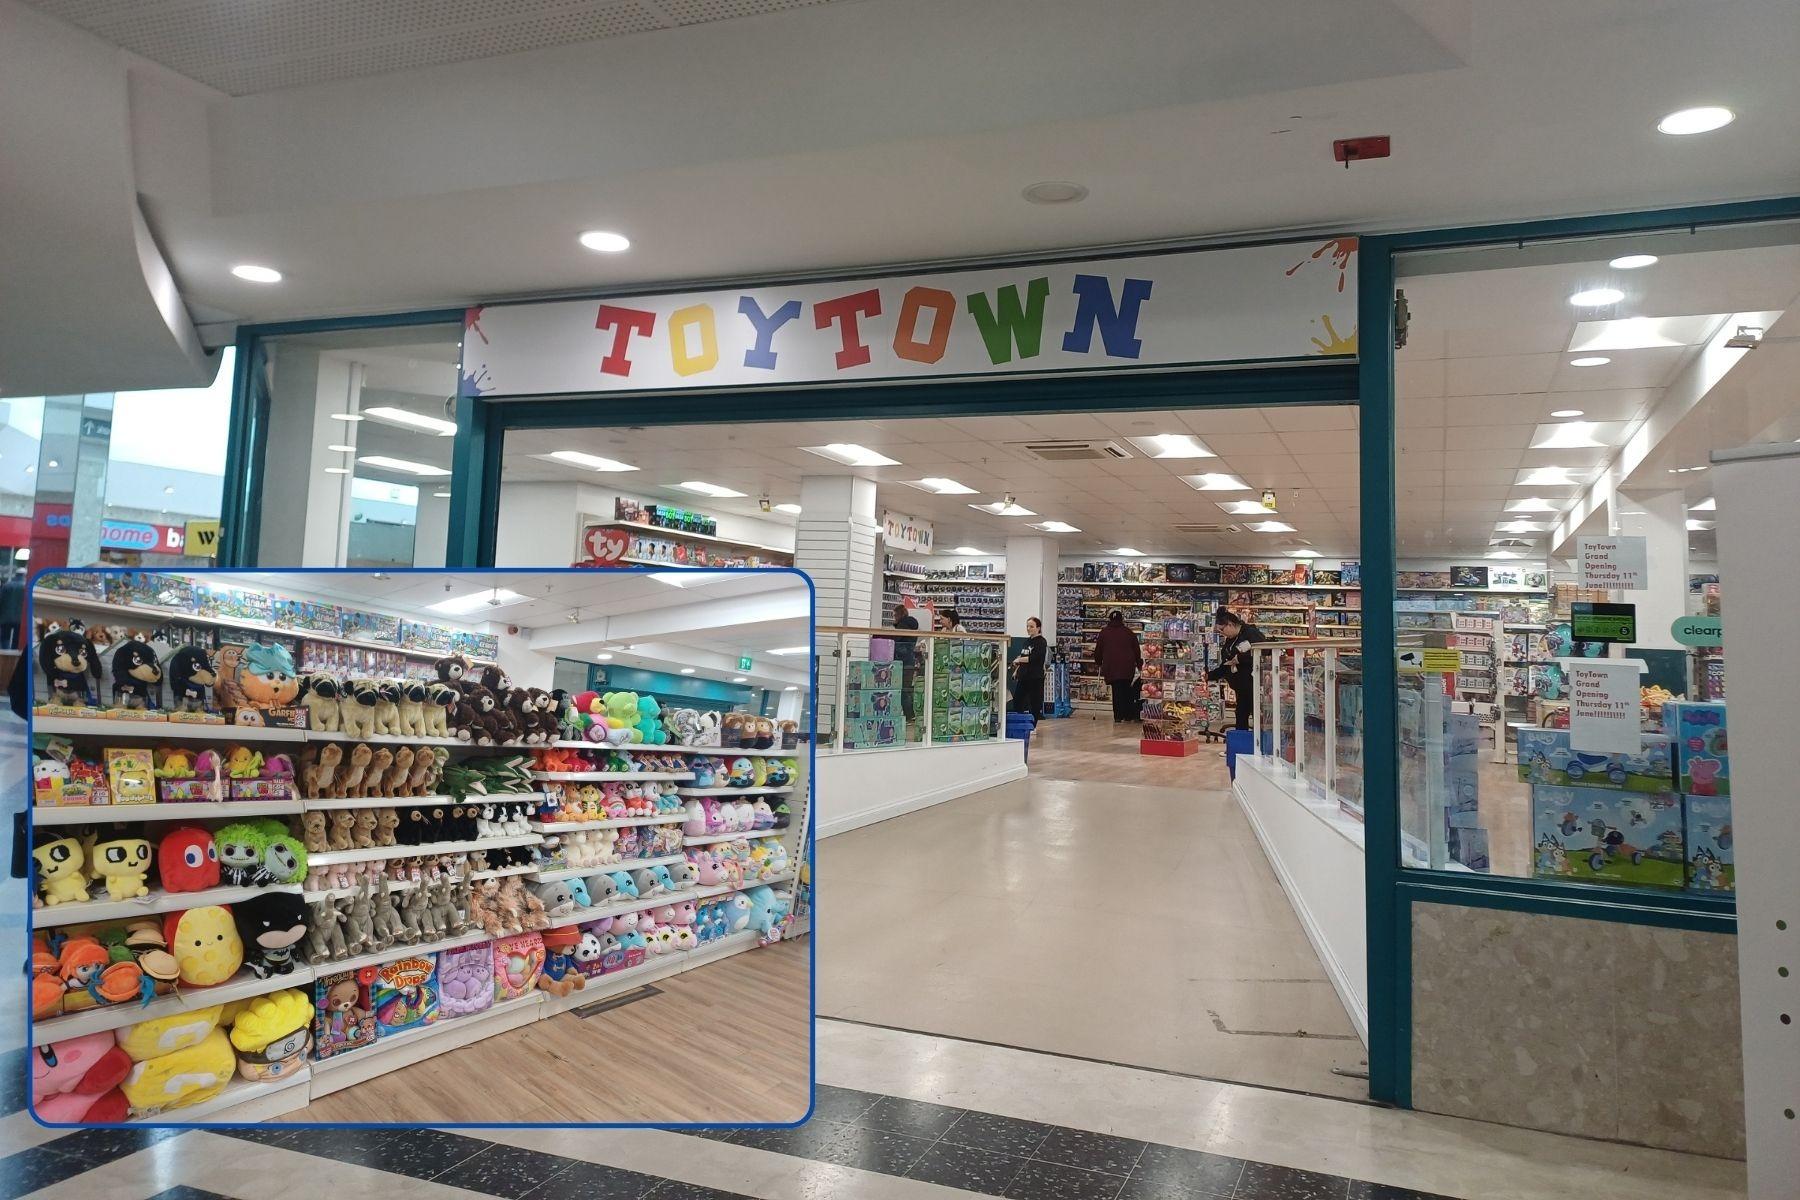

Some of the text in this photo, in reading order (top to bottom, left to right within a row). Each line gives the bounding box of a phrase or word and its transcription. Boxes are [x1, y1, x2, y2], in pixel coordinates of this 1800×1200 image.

[594, 274, 1153, 378] TOYTOWN
[166, 528, 184, 548] b
[887, 519, 930, 547] TOYTOWN
[589, 531, 624, 562] ty
[1585, 543, 1617, 551] ToyTown
[1585, 562, 1617, 571] Opening
[1585, 572, 1620, 580] Thursday
[1576, 671, 1608, 679] ToyTown
[1575, 680, 1601, 688] Grand
[1575, 690, 1609, 699] Opening
[1575, 700, 1612, 710] Thursday
[378, 957, 434, 984] Rainbow
[393, 973, 428, 990] Drops
